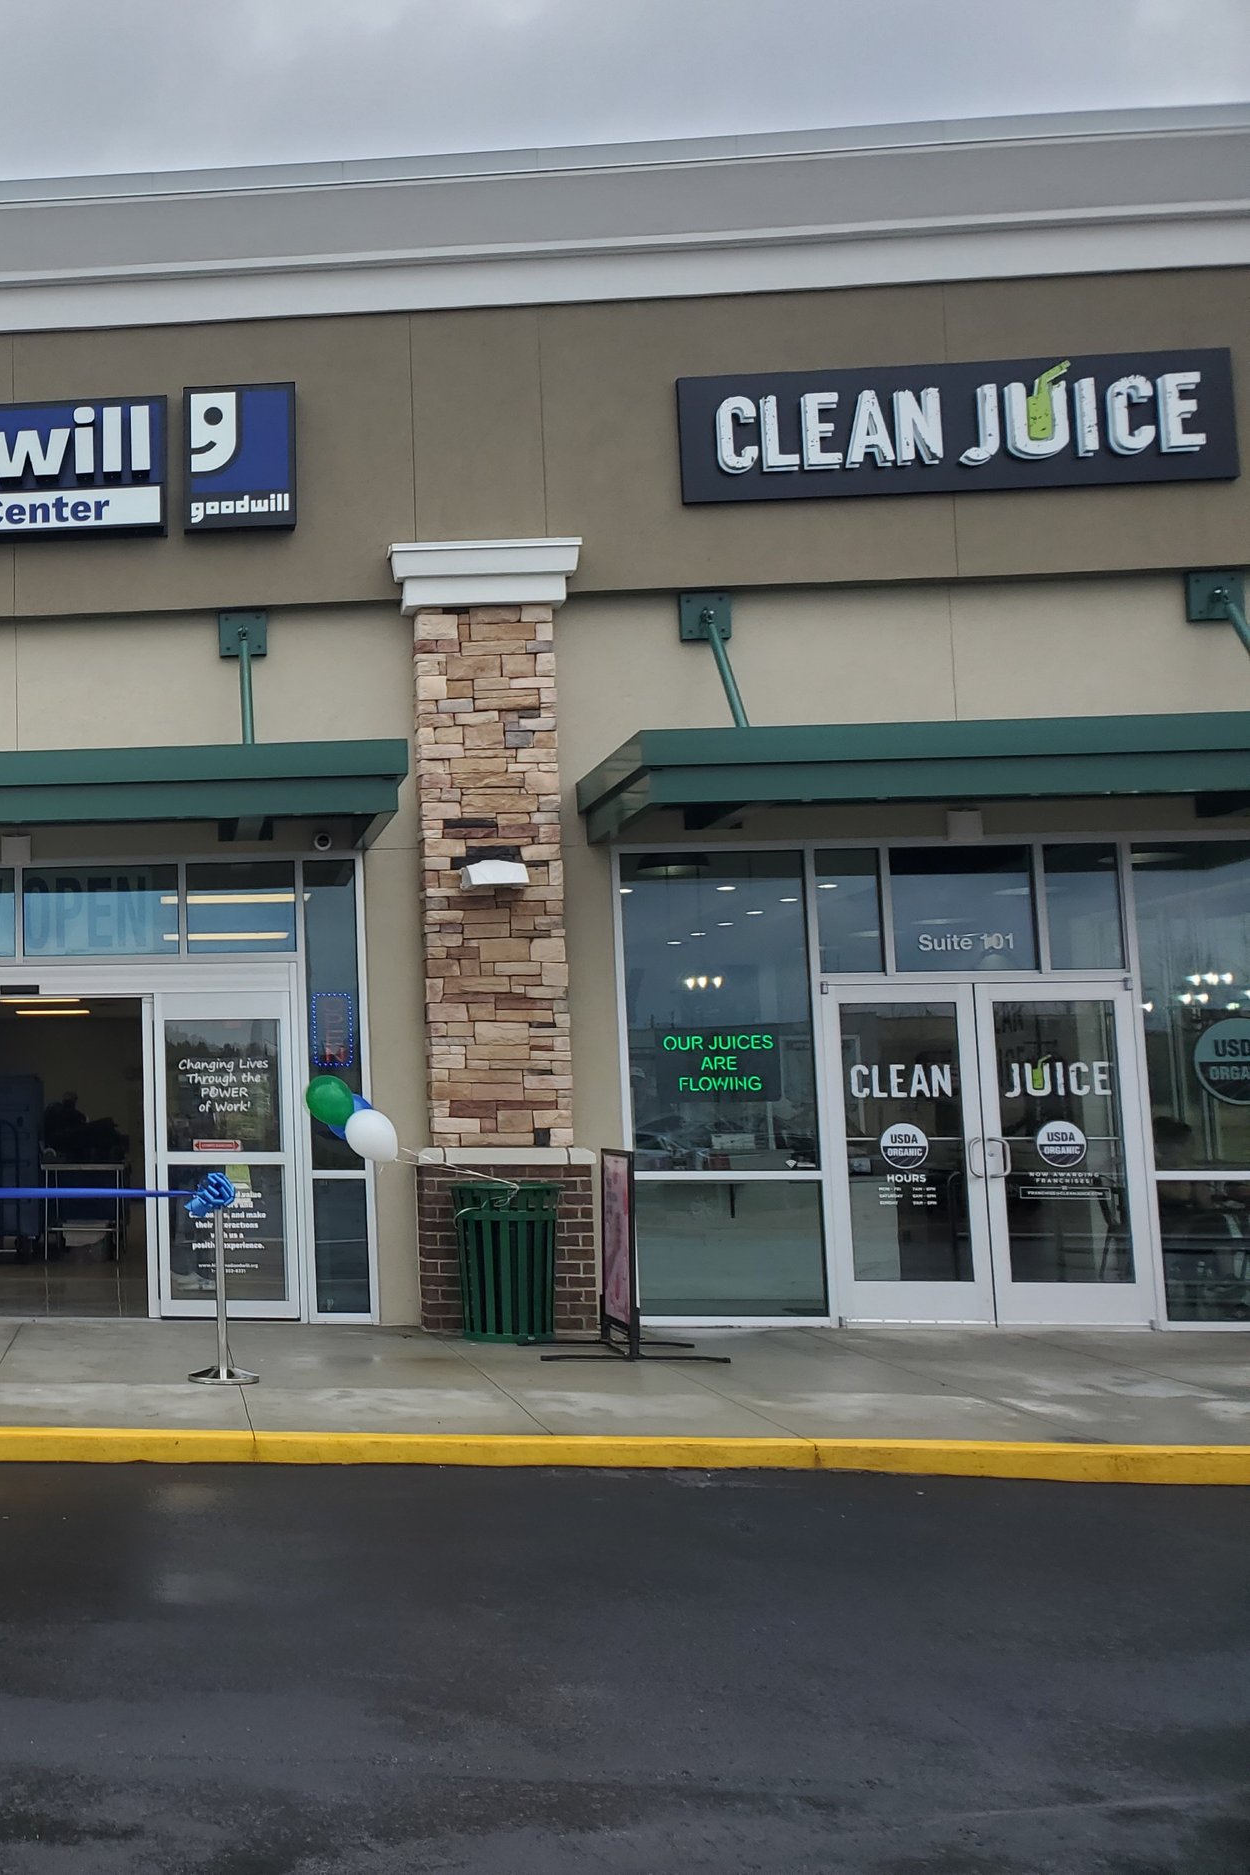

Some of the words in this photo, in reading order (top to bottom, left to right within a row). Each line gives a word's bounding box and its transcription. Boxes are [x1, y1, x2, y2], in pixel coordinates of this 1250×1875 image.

[716, 386, 945, 474] CLEAN
[958, 369, 1207, 467] JUICE
[190, 493, 290, 524] goodwill
[24, 875, 148, 949] OPEN
[918, 934, 973, 951] Suite
[980, 933, 1015, 951] 101
[663, 1035, 704, 1051] OUR
[708, 1034, 775, 1051] JUICES
[178, 1058, 235, 1072] Changing
[239, 1057, 269, 1069] Lives
[700, 1056, 738, 1071] ARE
[186, 1073, 237, 1087] Through
[241, 1071, 262, 1083] the
[678, 1076, 763, 1092] FLOWING
[850, 1063, 954, 1099] CLEAN
[1004, 1060, 1113, 1099] JUICE
[200, 1086, 249, 1099] POWER
[198, 1100, 211, 1112] of
[214, 1100, 251, 1112] Work!
[890, 1134, 918, 1144] USDA
[1046, 1131, 1076, 1142] USDA
[887, 1147, 923, 1157] ORGANIC
[1043, 1145, 1081, 1155] ORGANIC
[886, 1173, 927, 1183] HOURS
[231, 1210, 245, 1218] and
[246, 1210, 267, 1218] make
[195, 1220, 214, 1229] their
